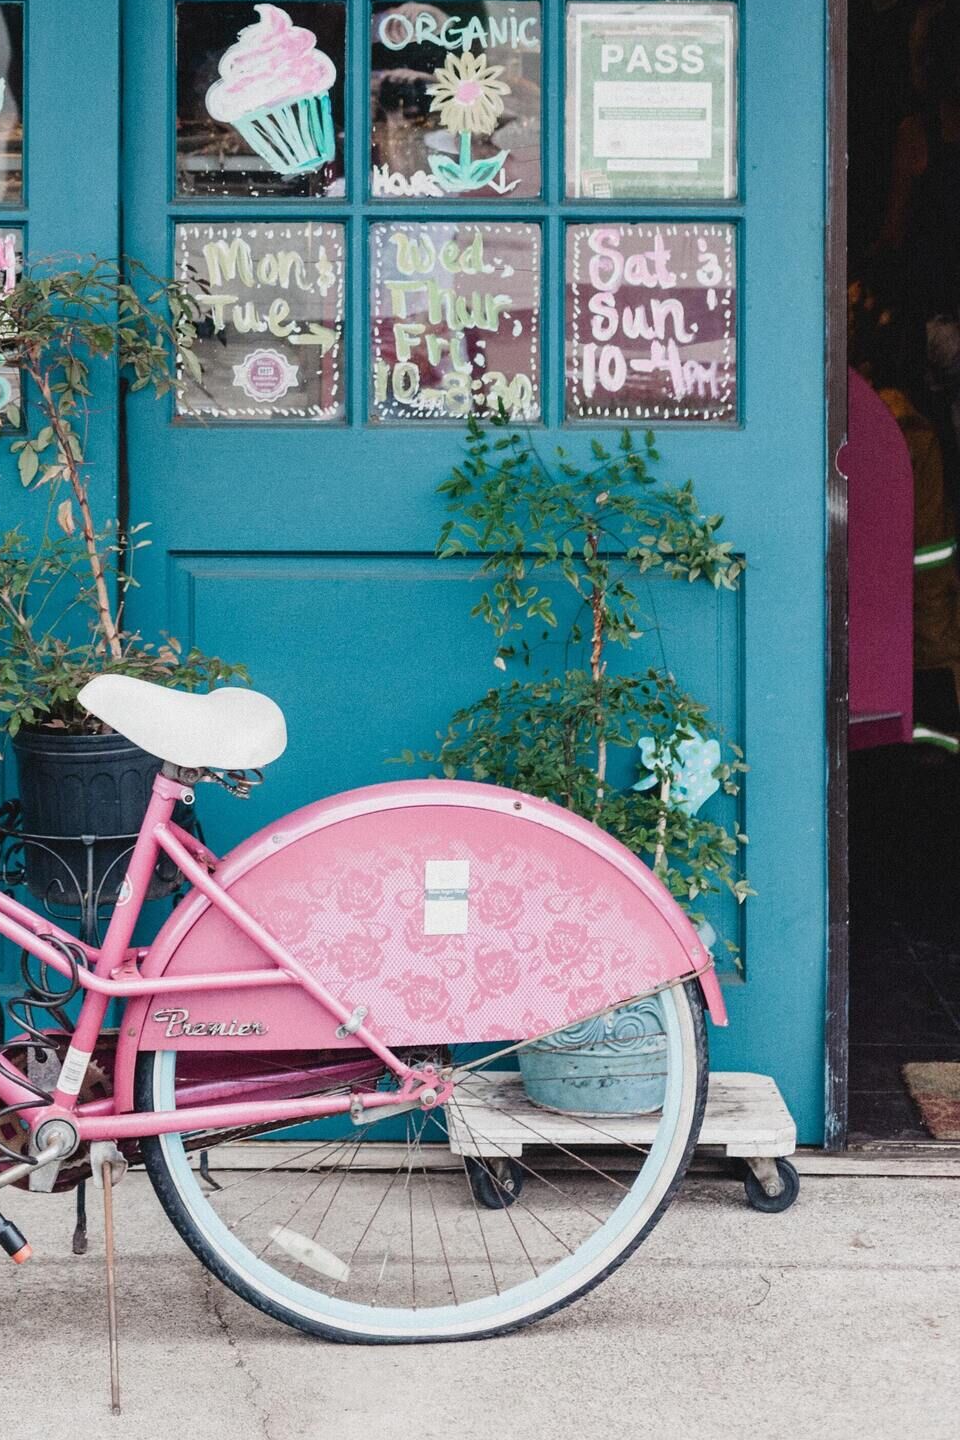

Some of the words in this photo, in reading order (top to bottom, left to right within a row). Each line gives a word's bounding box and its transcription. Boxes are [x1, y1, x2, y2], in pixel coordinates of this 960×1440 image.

[379, 8, 538, 52] ORGANIC
[601, 43, 705, 74] PASS
[154, 1008, 269, 1037] Premier
